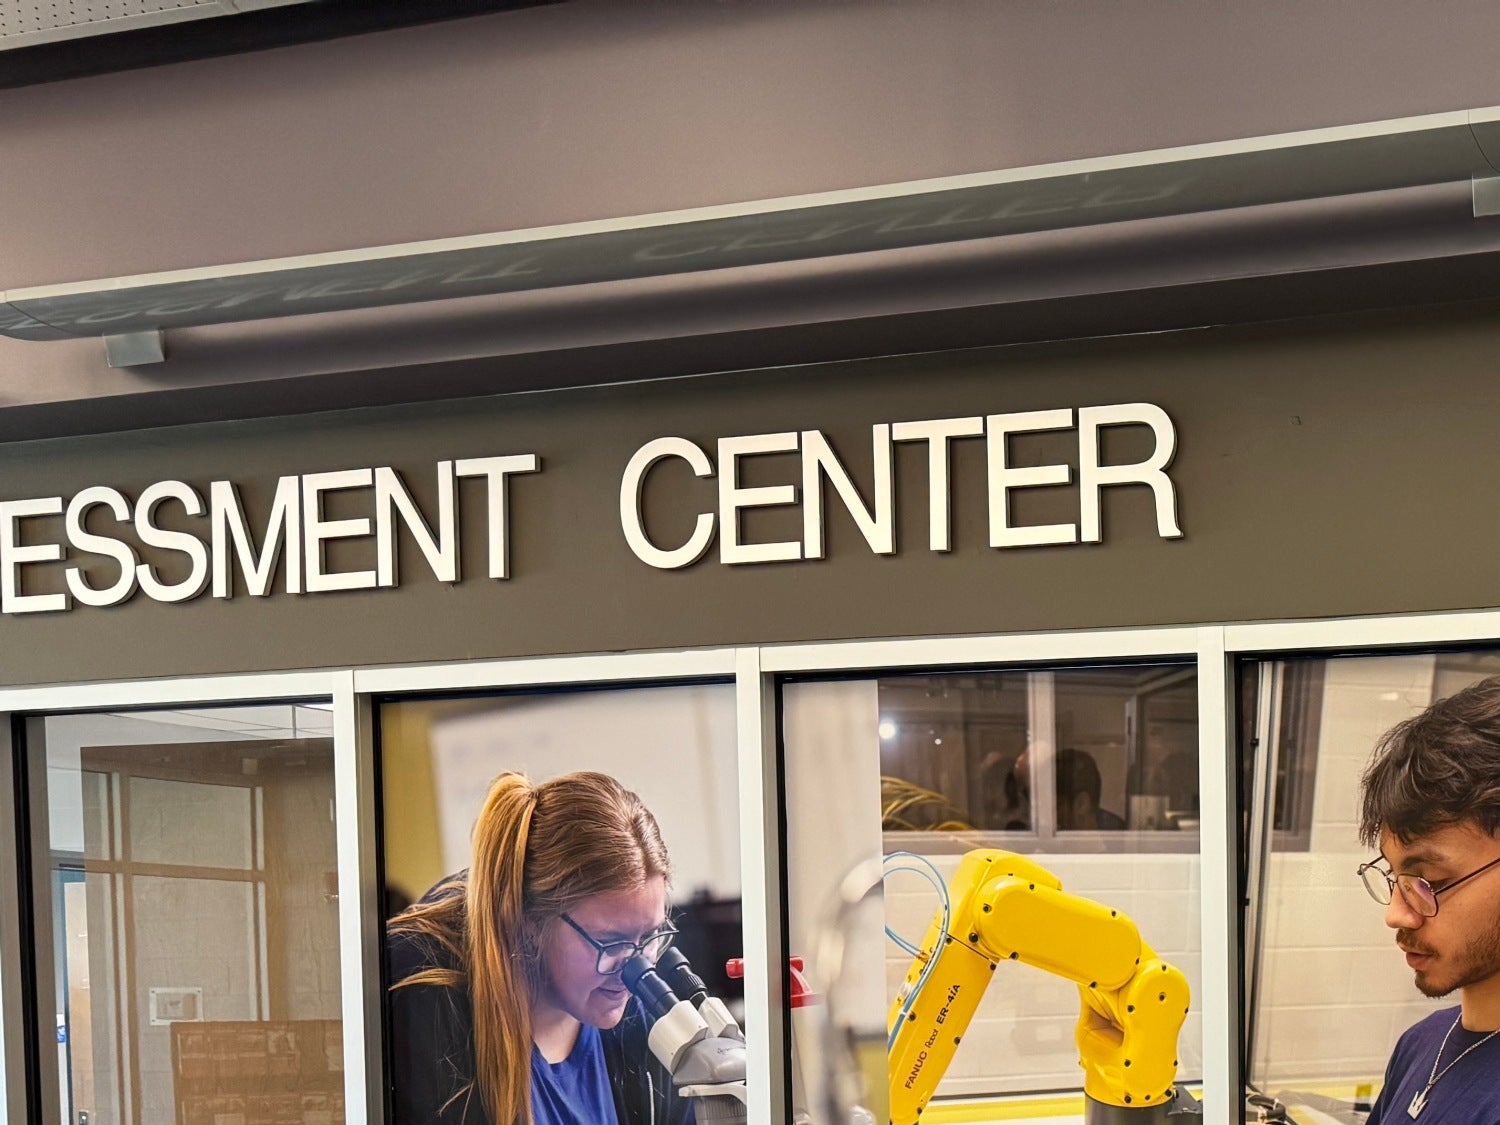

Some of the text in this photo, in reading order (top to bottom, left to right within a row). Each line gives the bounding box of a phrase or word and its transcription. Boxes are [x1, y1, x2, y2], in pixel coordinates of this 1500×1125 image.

[0, 401, 1184, 615] ESSMENT CENTER
[905, 1050, 928, 1090] FANUC
